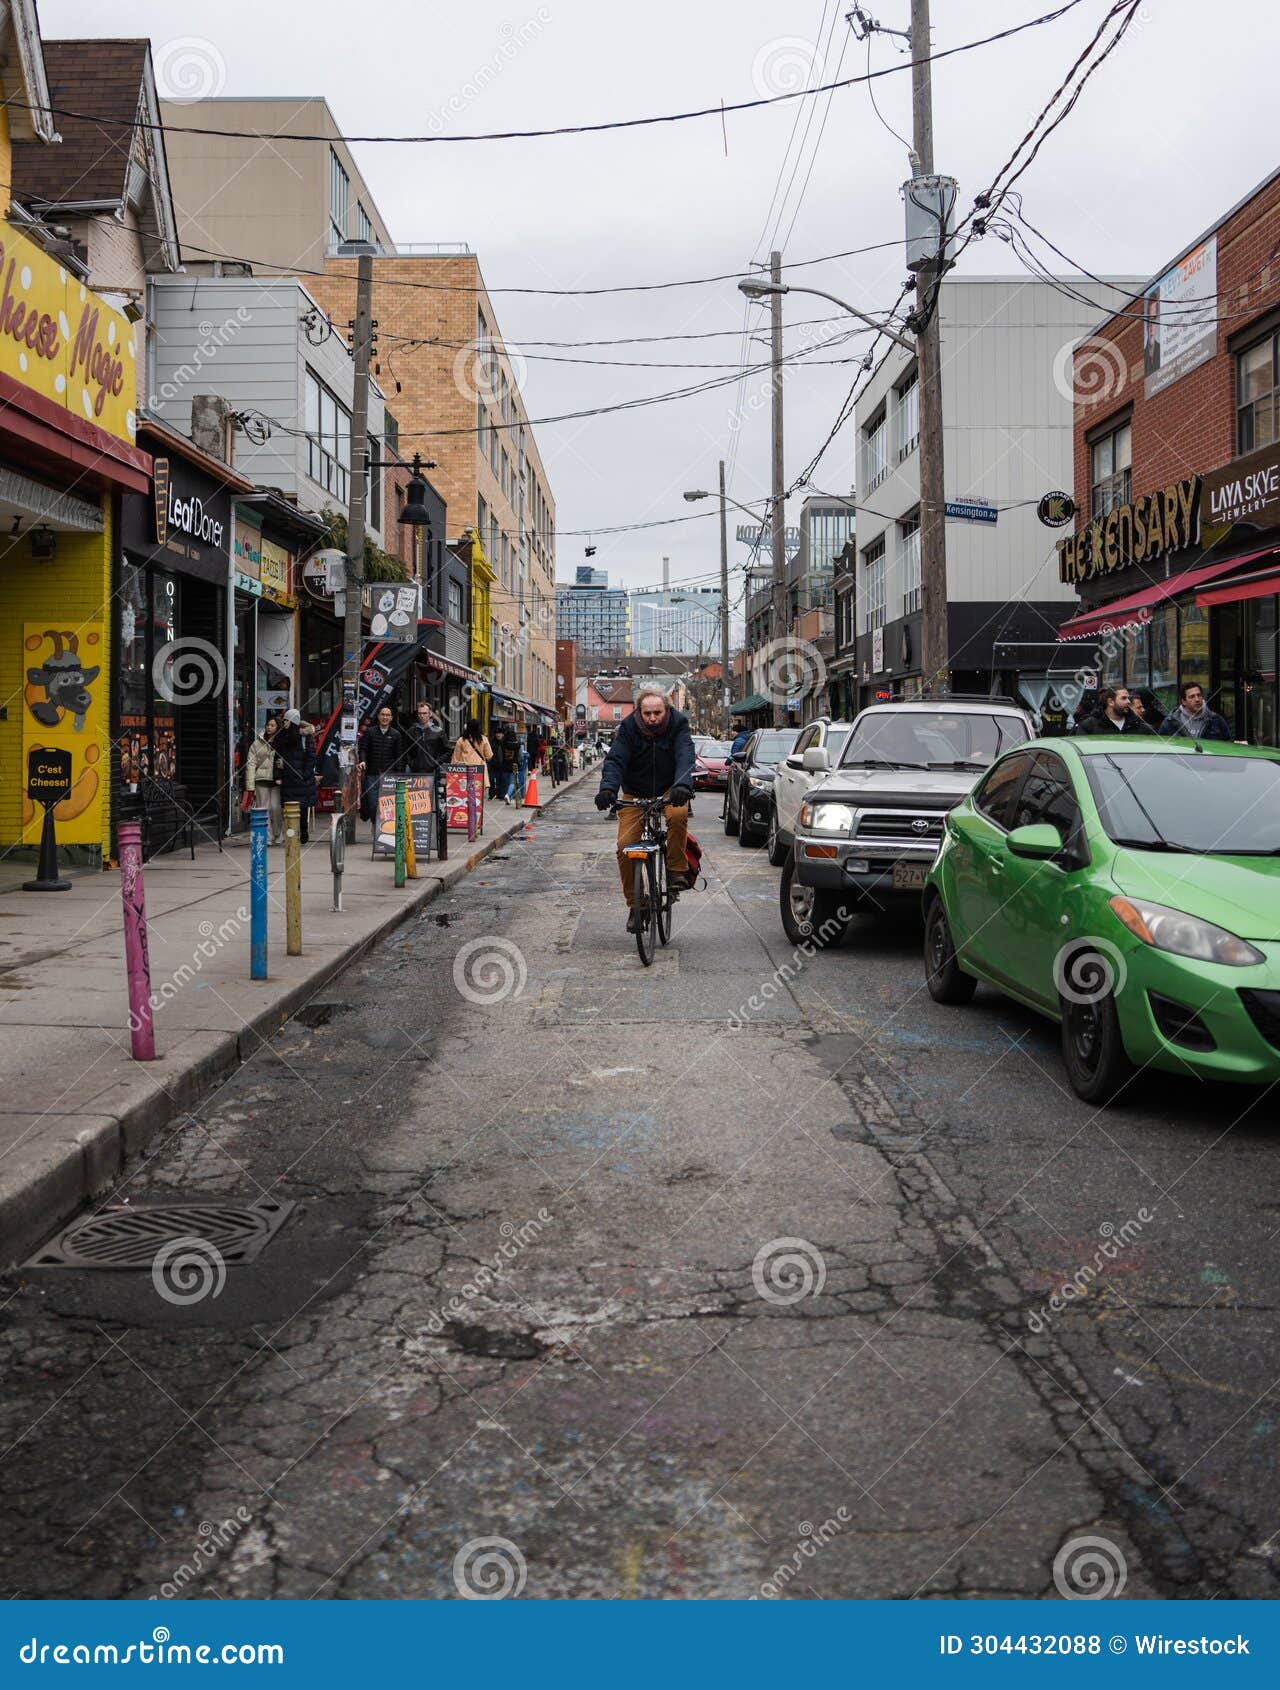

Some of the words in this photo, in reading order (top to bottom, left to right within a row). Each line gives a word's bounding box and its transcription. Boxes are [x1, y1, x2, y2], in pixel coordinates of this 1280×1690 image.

[70, 303, 125, 417] Magic
[1211, 479, 1242, 514] LAYA
[1244, 465, 1279, 500] SKYE
[946, 503, 988, 519] Kensington
[1221, 497, 1267, 523] JEWELRY
[1056, 531, 1087, 584] THE
[166, 581, 175, 642] OEN
[30, 777, 69, 788] Cheese!
[38, 764, 62, 775] C'est
